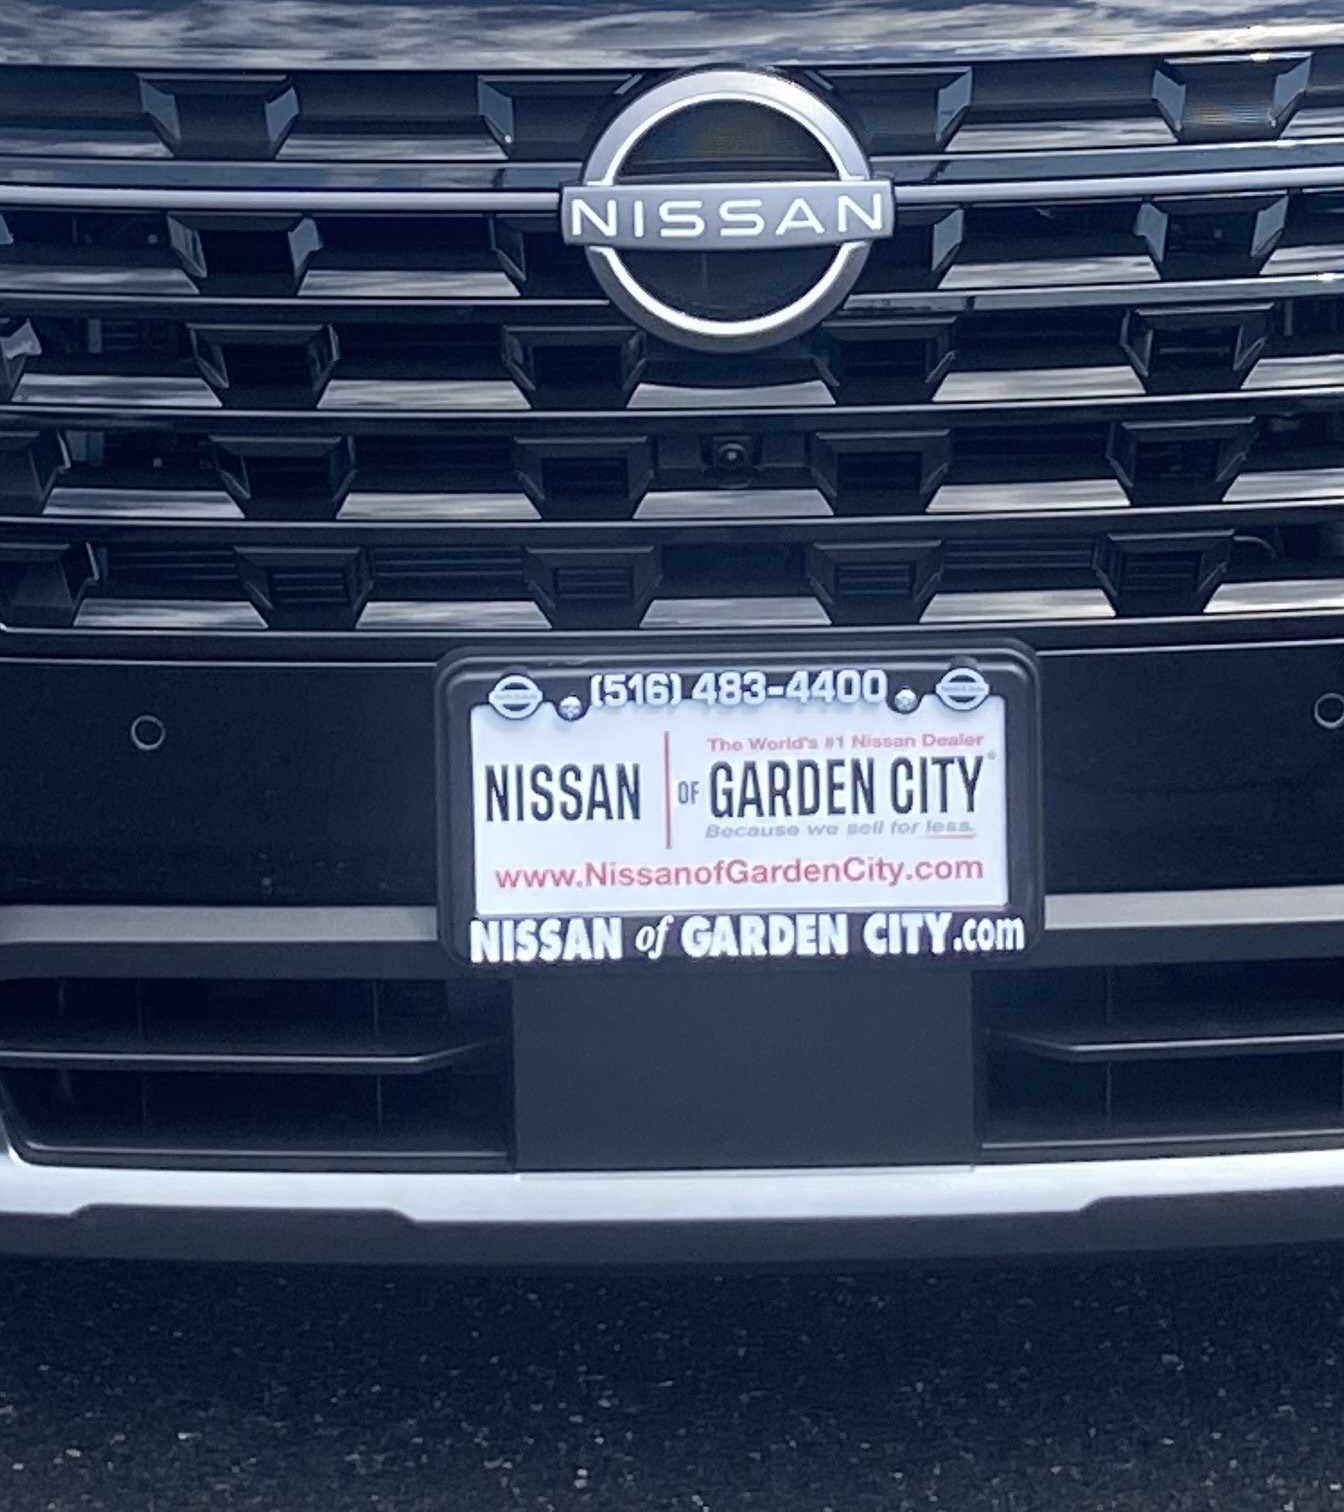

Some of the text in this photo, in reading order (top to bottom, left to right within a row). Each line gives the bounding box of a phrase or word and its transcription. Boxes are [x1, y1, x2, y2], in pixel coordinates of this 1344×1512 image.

[571, 193, 882, 238] NISSAN
[590, 669, 888, 707] (516) 483-4400
[707, 733, 984, 751] The World's #1 Nissan Dealer
[485, 755, 984, 822] NISSAN OF GARDEN CITY
[705, 823, 800, 839] Because
[806, 824, 839, 836] we
[847, 820, 884, 835] sell
[890, 819, 919, 834] for
[495, 856, 984, 889] www.NissanofGardenCity.com
[470, 911, 1025, 963] NISSAN of GARDEN CITY.com
